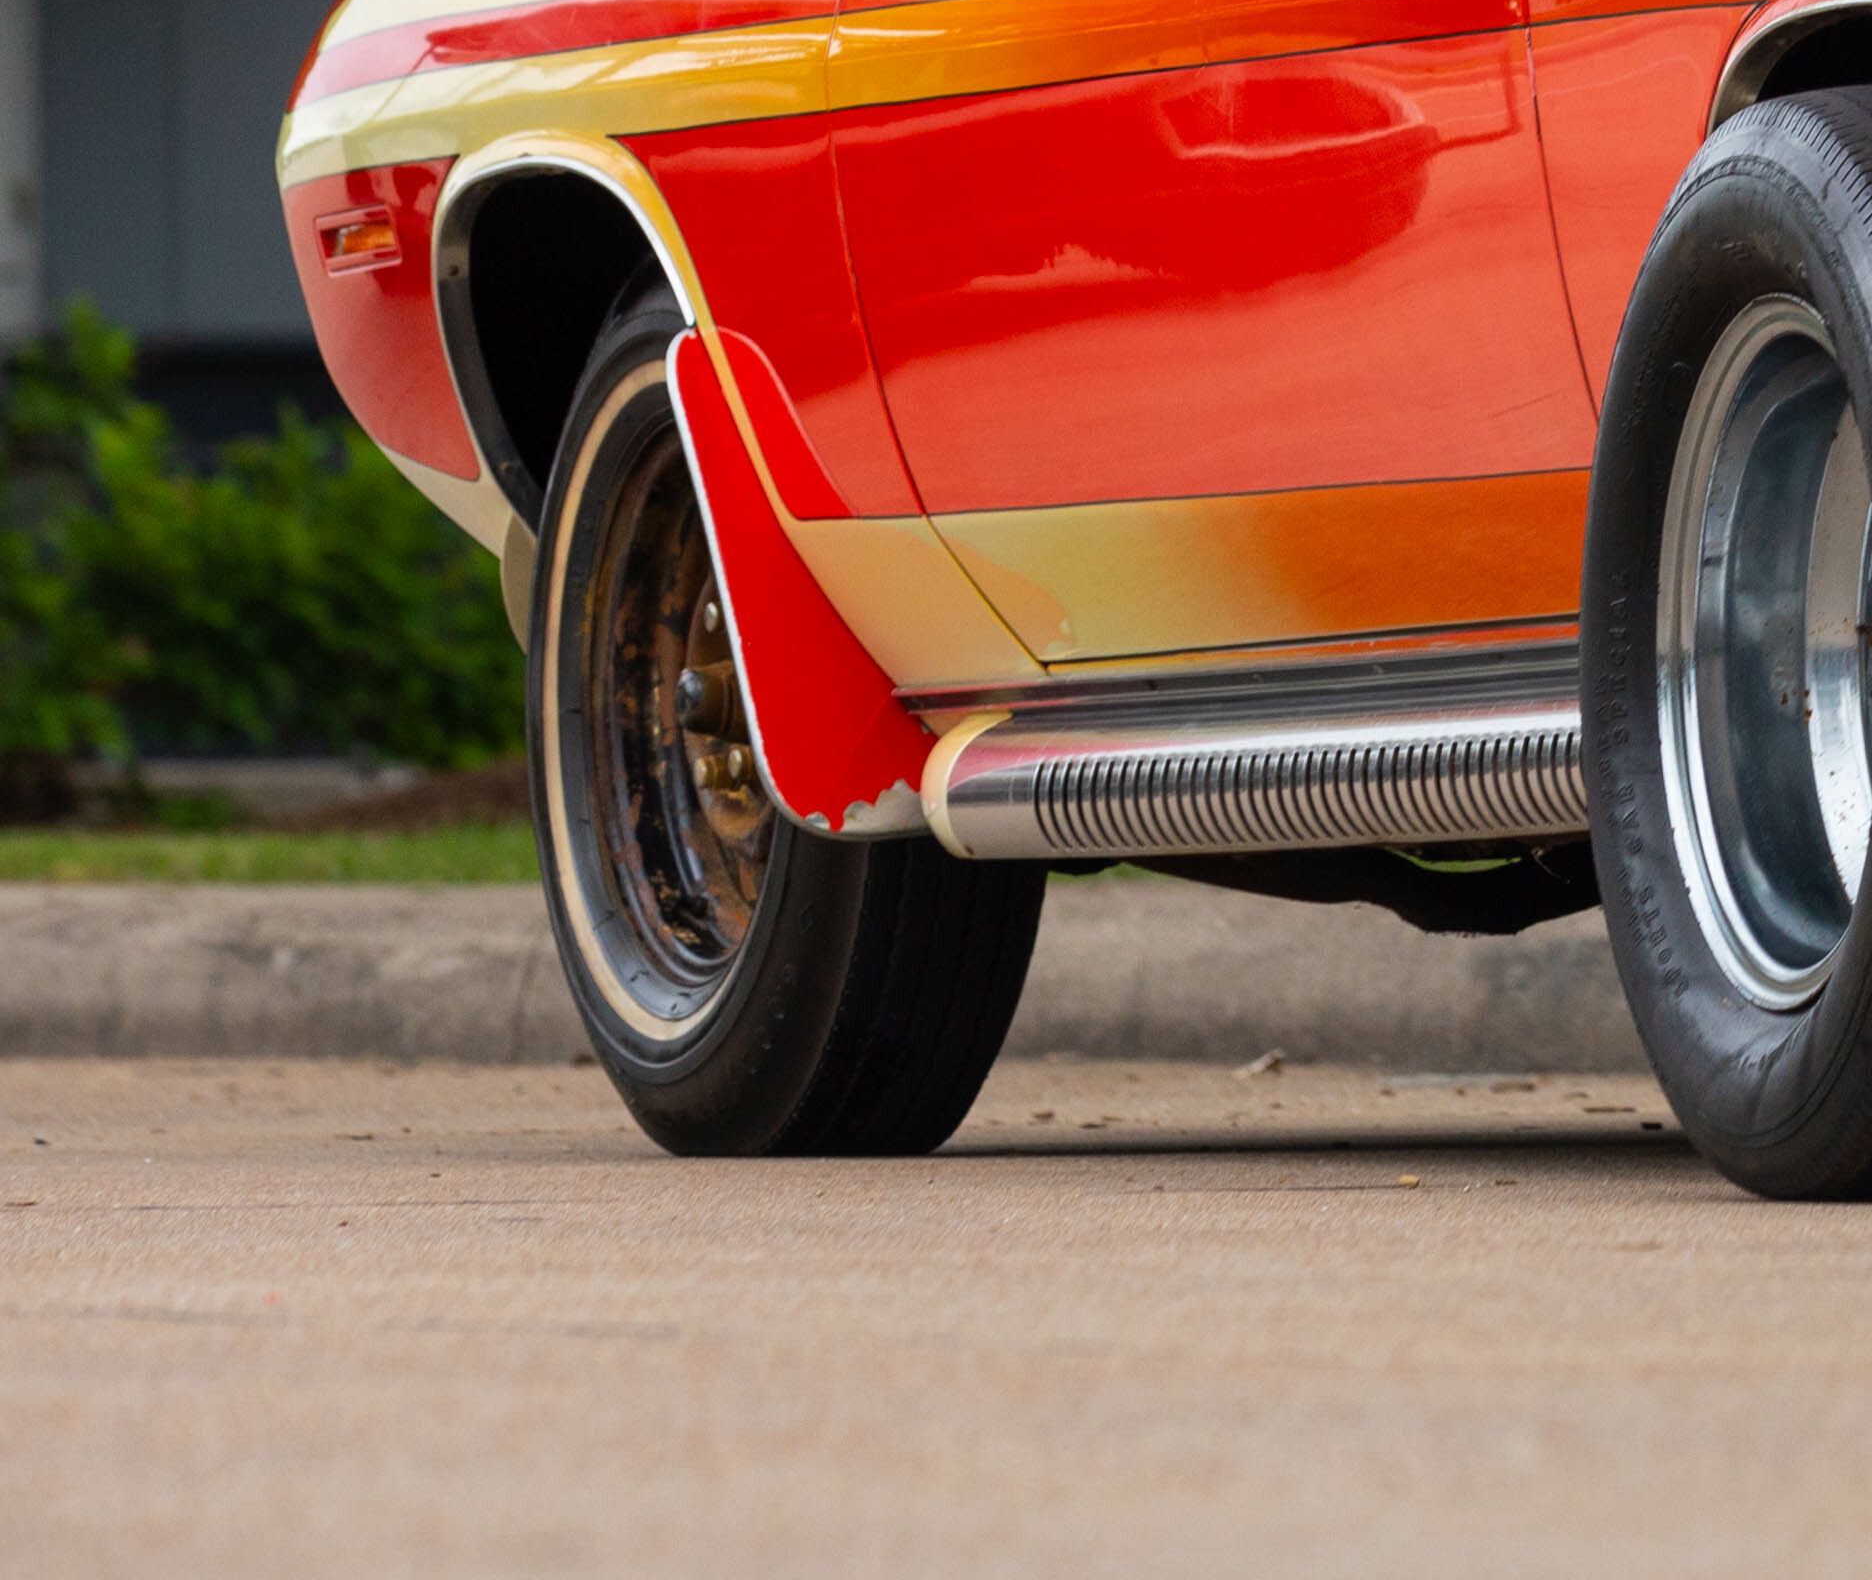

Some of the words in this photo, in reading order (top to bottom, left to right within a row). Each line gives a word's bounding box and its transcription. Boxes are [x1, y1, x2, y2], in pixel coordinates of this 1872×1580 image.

[1607, 567, 1632, 747] SPECIAL
[1616, 779, 1644, 856] CAR
[1637, 885, 1690, 998] SPORTS
